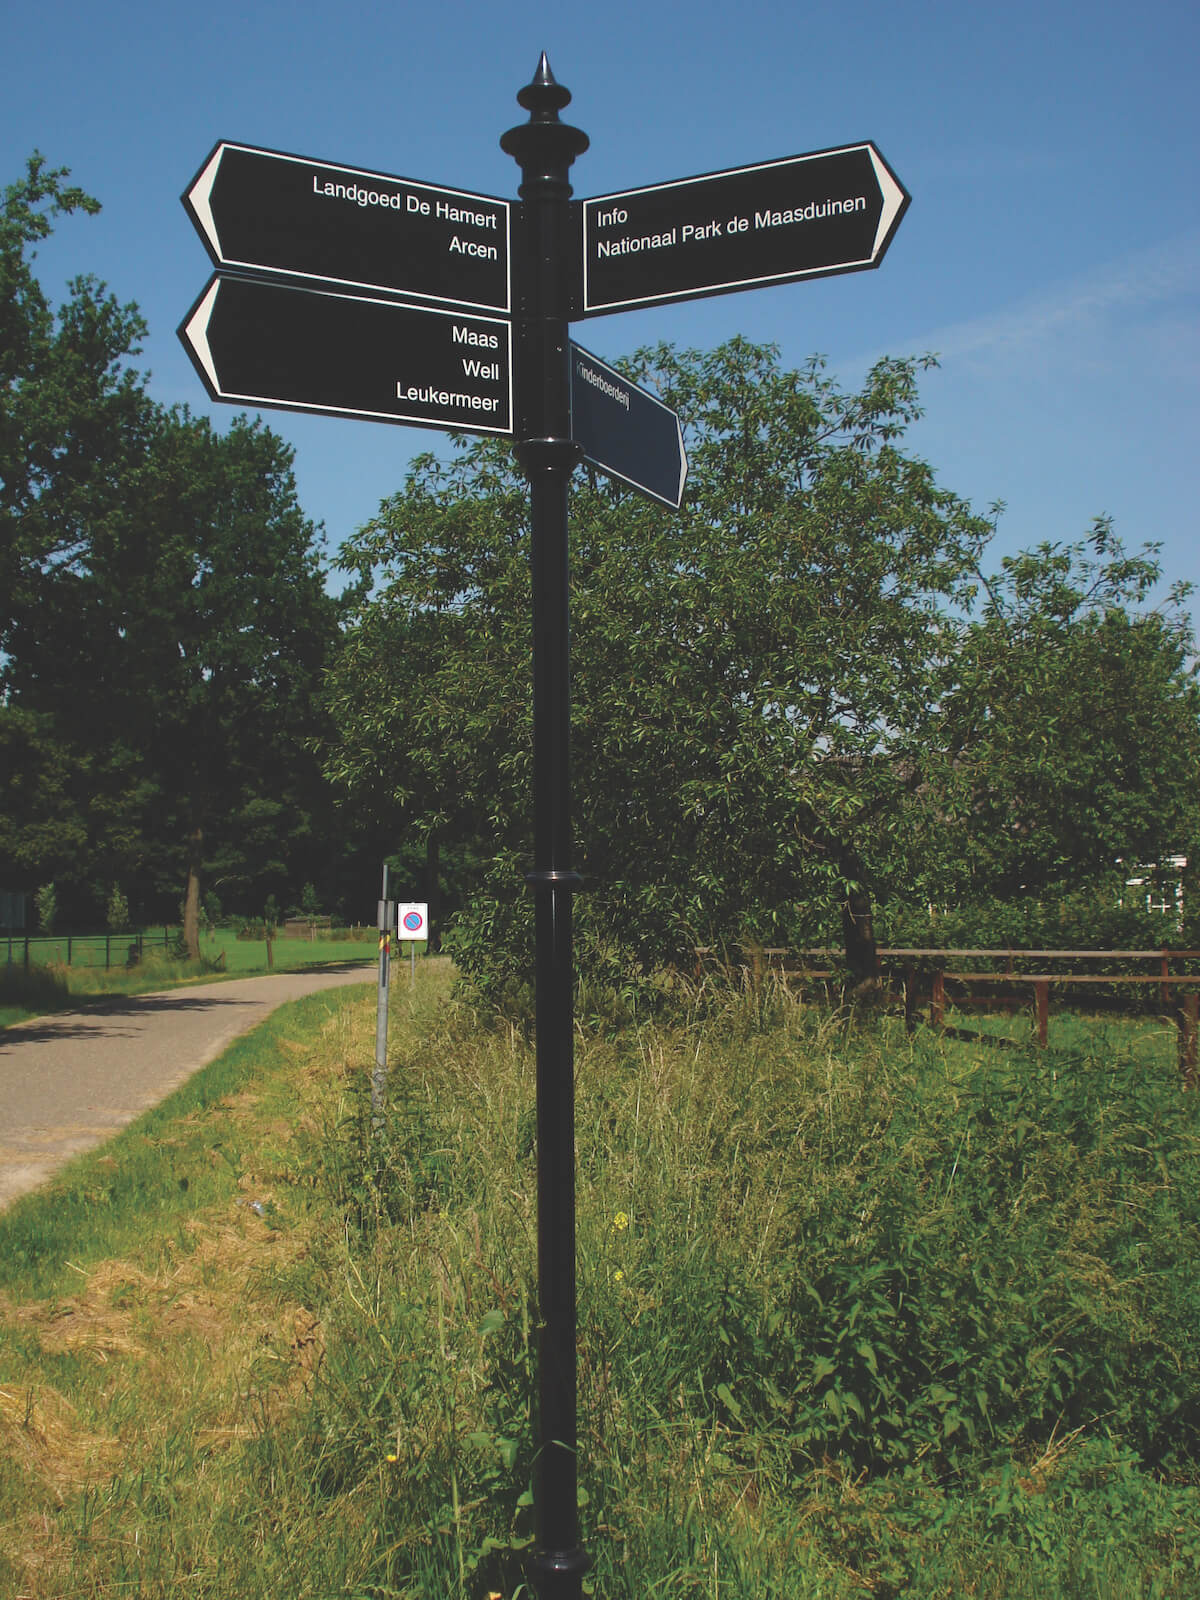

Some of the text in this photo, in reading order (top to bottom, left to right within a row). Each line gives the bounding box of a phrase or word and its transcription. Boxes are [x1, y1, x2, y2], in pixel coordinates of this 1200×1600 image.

[313, 176, 497, 229] Landgoed De Hamert
[597, 208, 628, 227] Info
[597, 195, 866, 258] Nationaal Park de Maasduinen
[449, 236, 498, 260] Arcen
[452, 325, 498, 348] Maas
[462, 359, 499, 380] Well
[396, 382, 499, 411] Leukermeer
